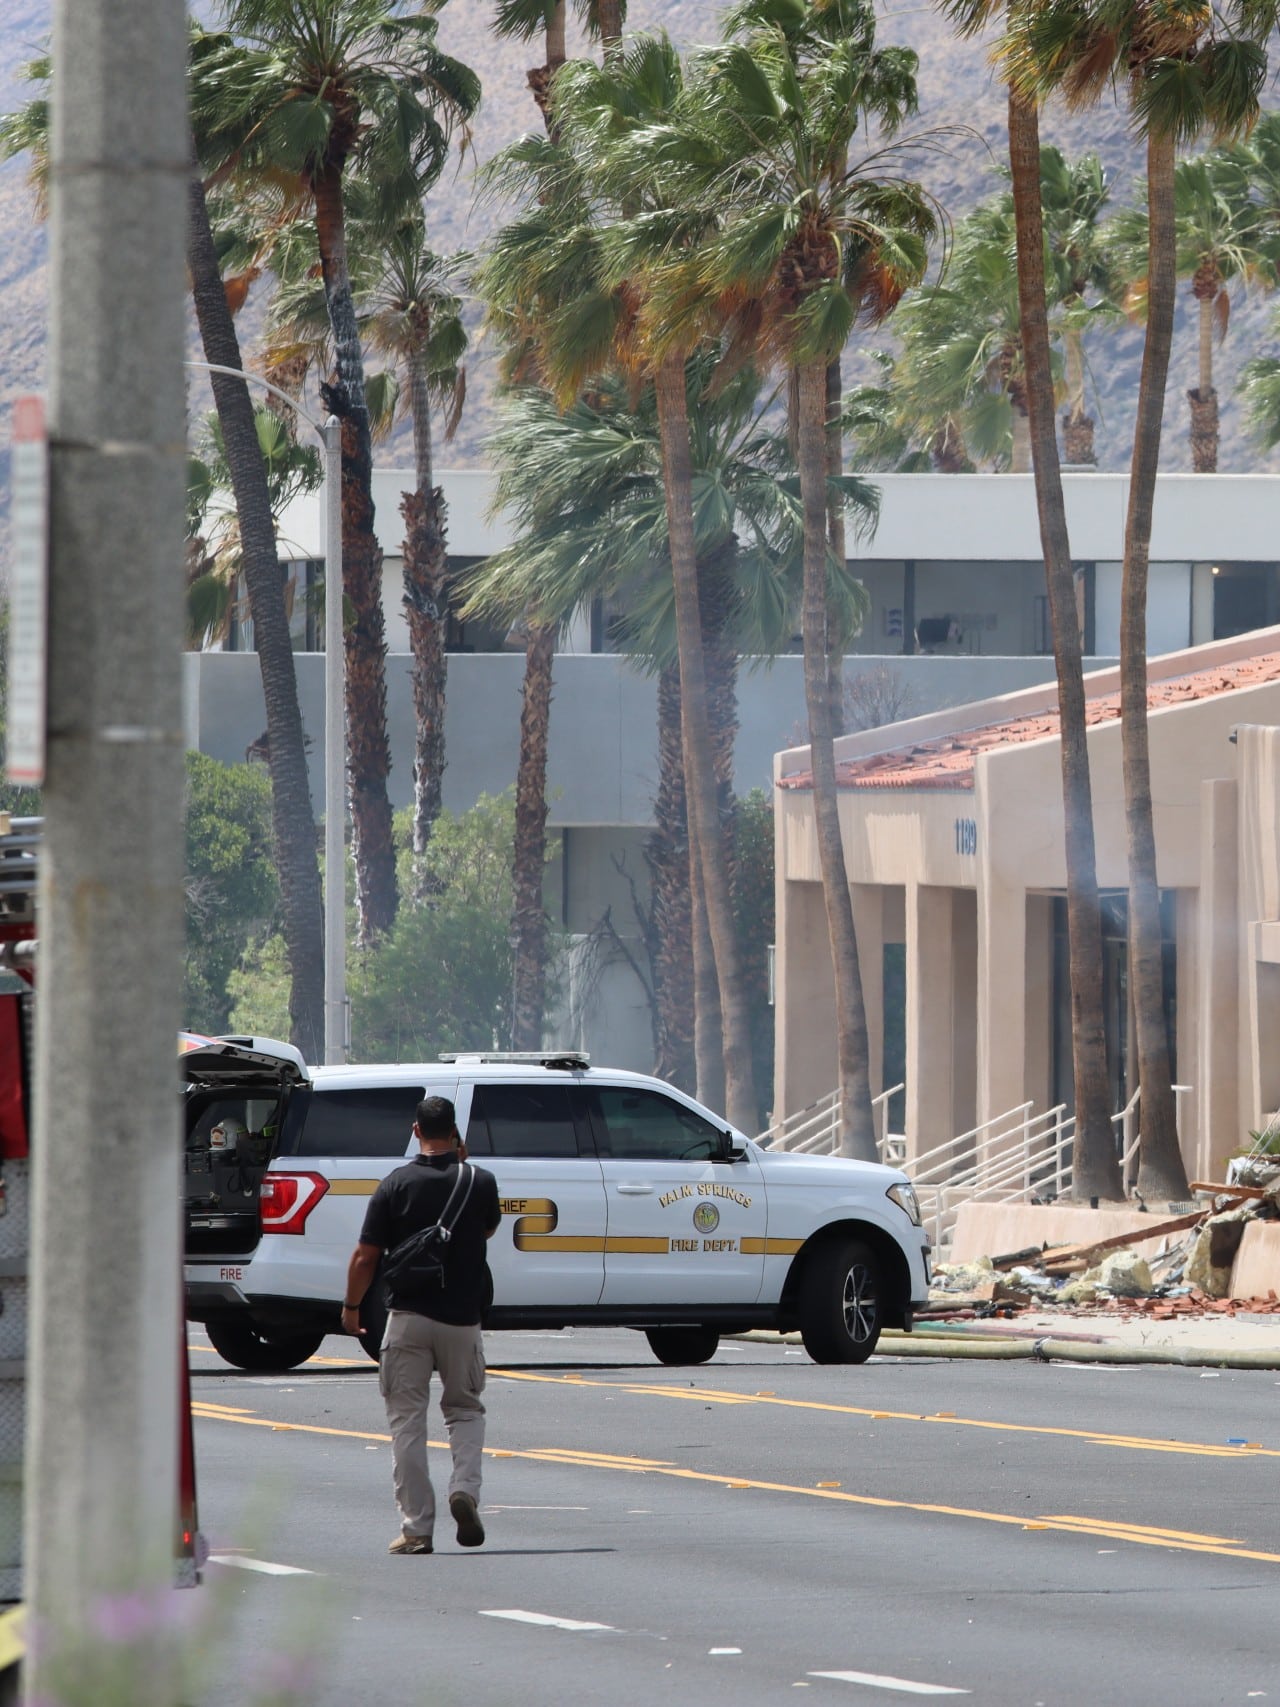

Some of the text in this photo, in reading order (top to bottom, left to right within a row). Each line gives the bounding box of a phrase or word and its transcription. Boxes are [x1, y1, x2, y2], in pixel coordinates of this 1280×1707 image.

[659, 1183, 752, 1208] PALM SPRINGS
[499, 1200, 528, 1212] HIEF
[671, 1239, 737, 1252] FIRE DEPT.
[220, 1268, 242, 1280] FIRE
